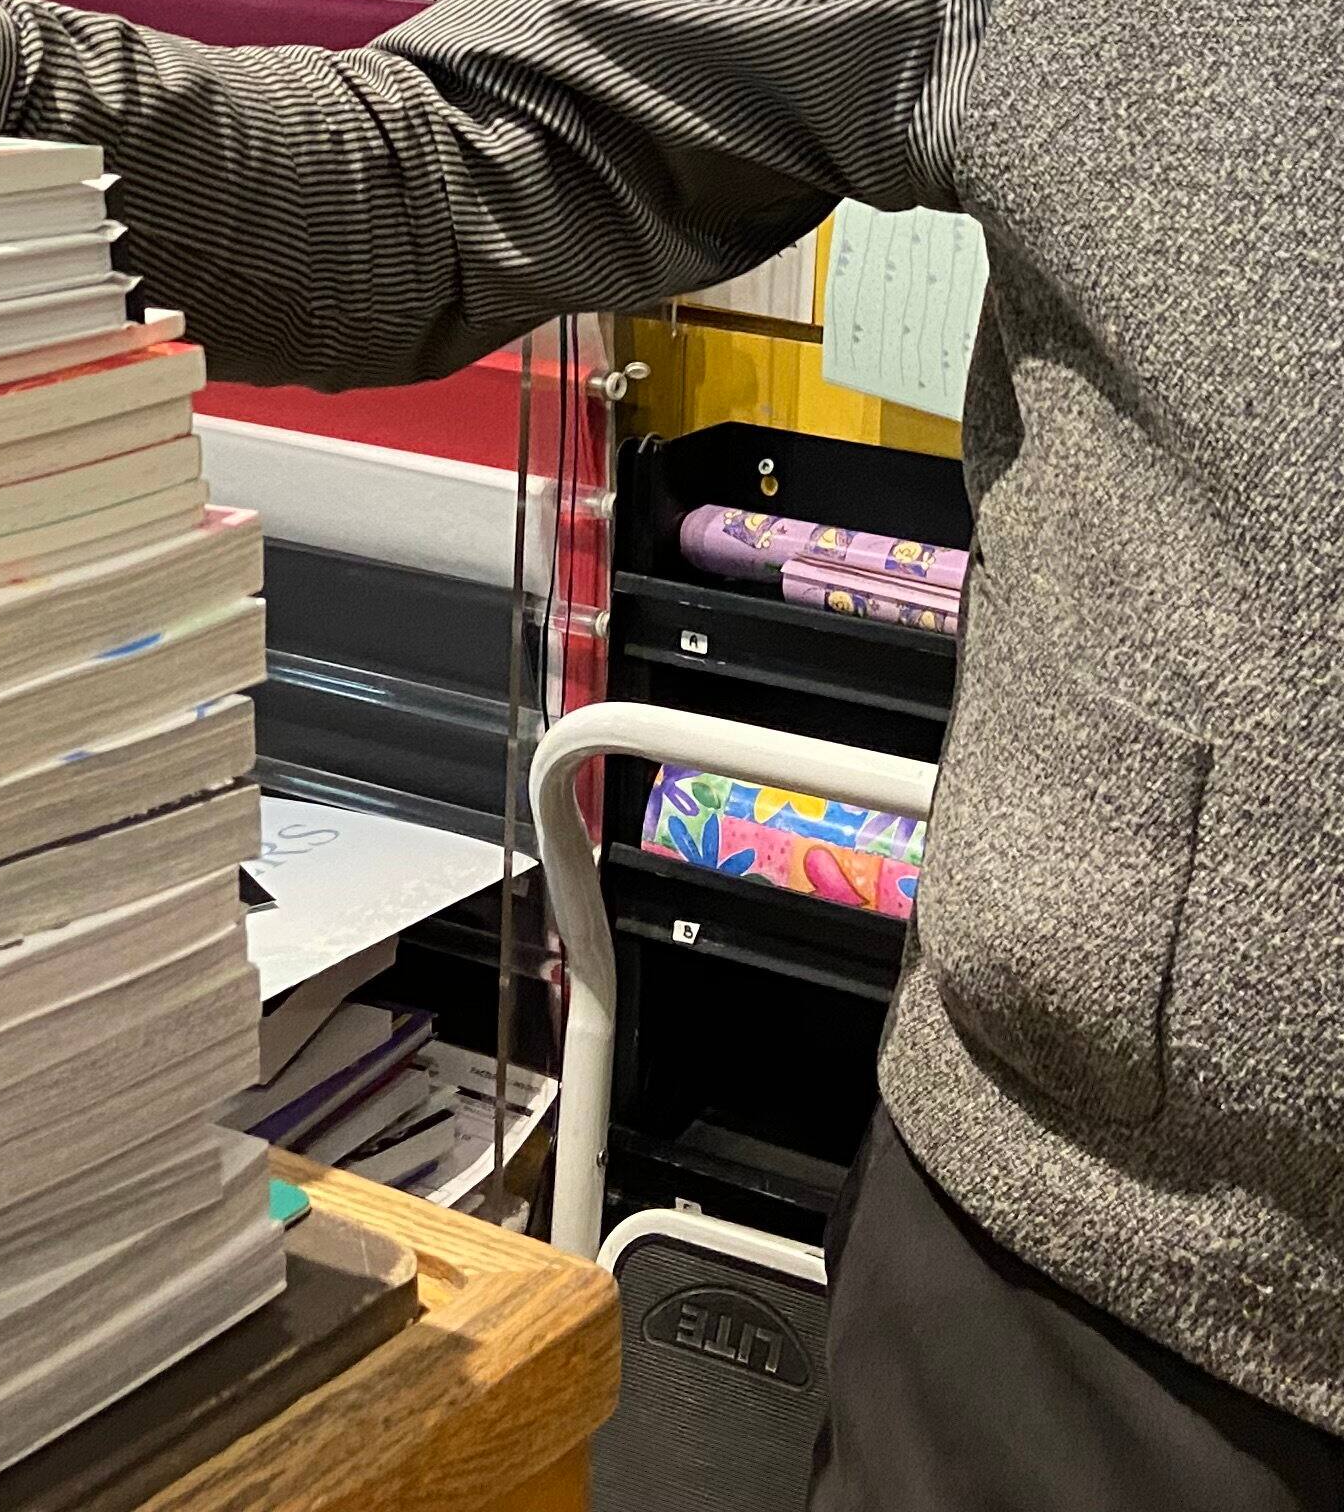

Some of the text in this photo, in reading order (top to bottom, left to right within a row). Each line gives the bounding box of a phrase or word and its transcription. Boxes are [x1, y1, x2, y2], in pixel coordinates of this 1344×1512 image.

[689, 634, 698, 648] A
[683, 924, 694, 939] B
[676, 1303, 784, 1374] LITE
